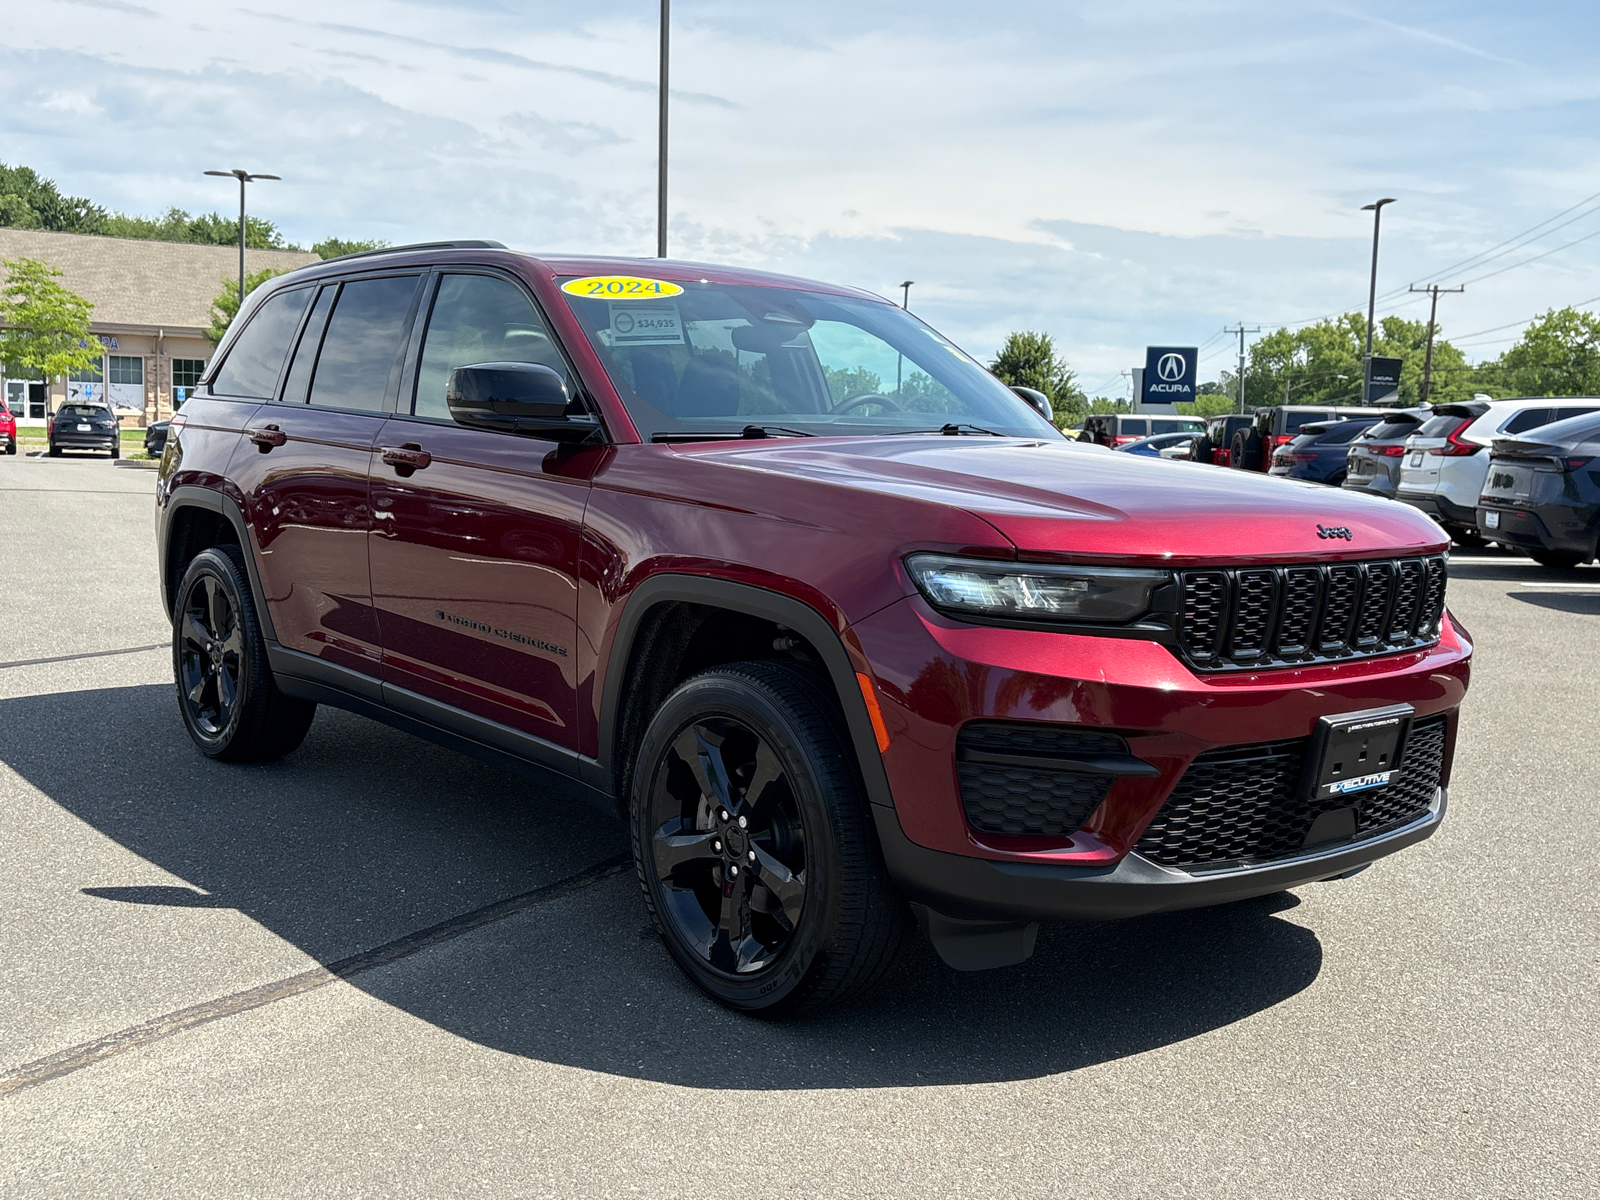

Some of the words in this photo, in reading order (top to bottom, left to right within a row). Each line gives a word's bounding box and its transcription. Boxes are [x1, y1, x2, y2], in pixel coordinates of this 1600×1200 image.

[587, 281, 664, 294] 2024
[638, 319, 675, 329] $34,935
[97, 337, 119, 350] PA
[1149, 383, 1191, 393] ACURA
[1316, 524, 1353, 541] Jeep
[447, 615, 491, 633] GRAND
[494, 627, 568, 657] CHEROKEE
[1329, 772, 1391, 793] EXECUTIVE
